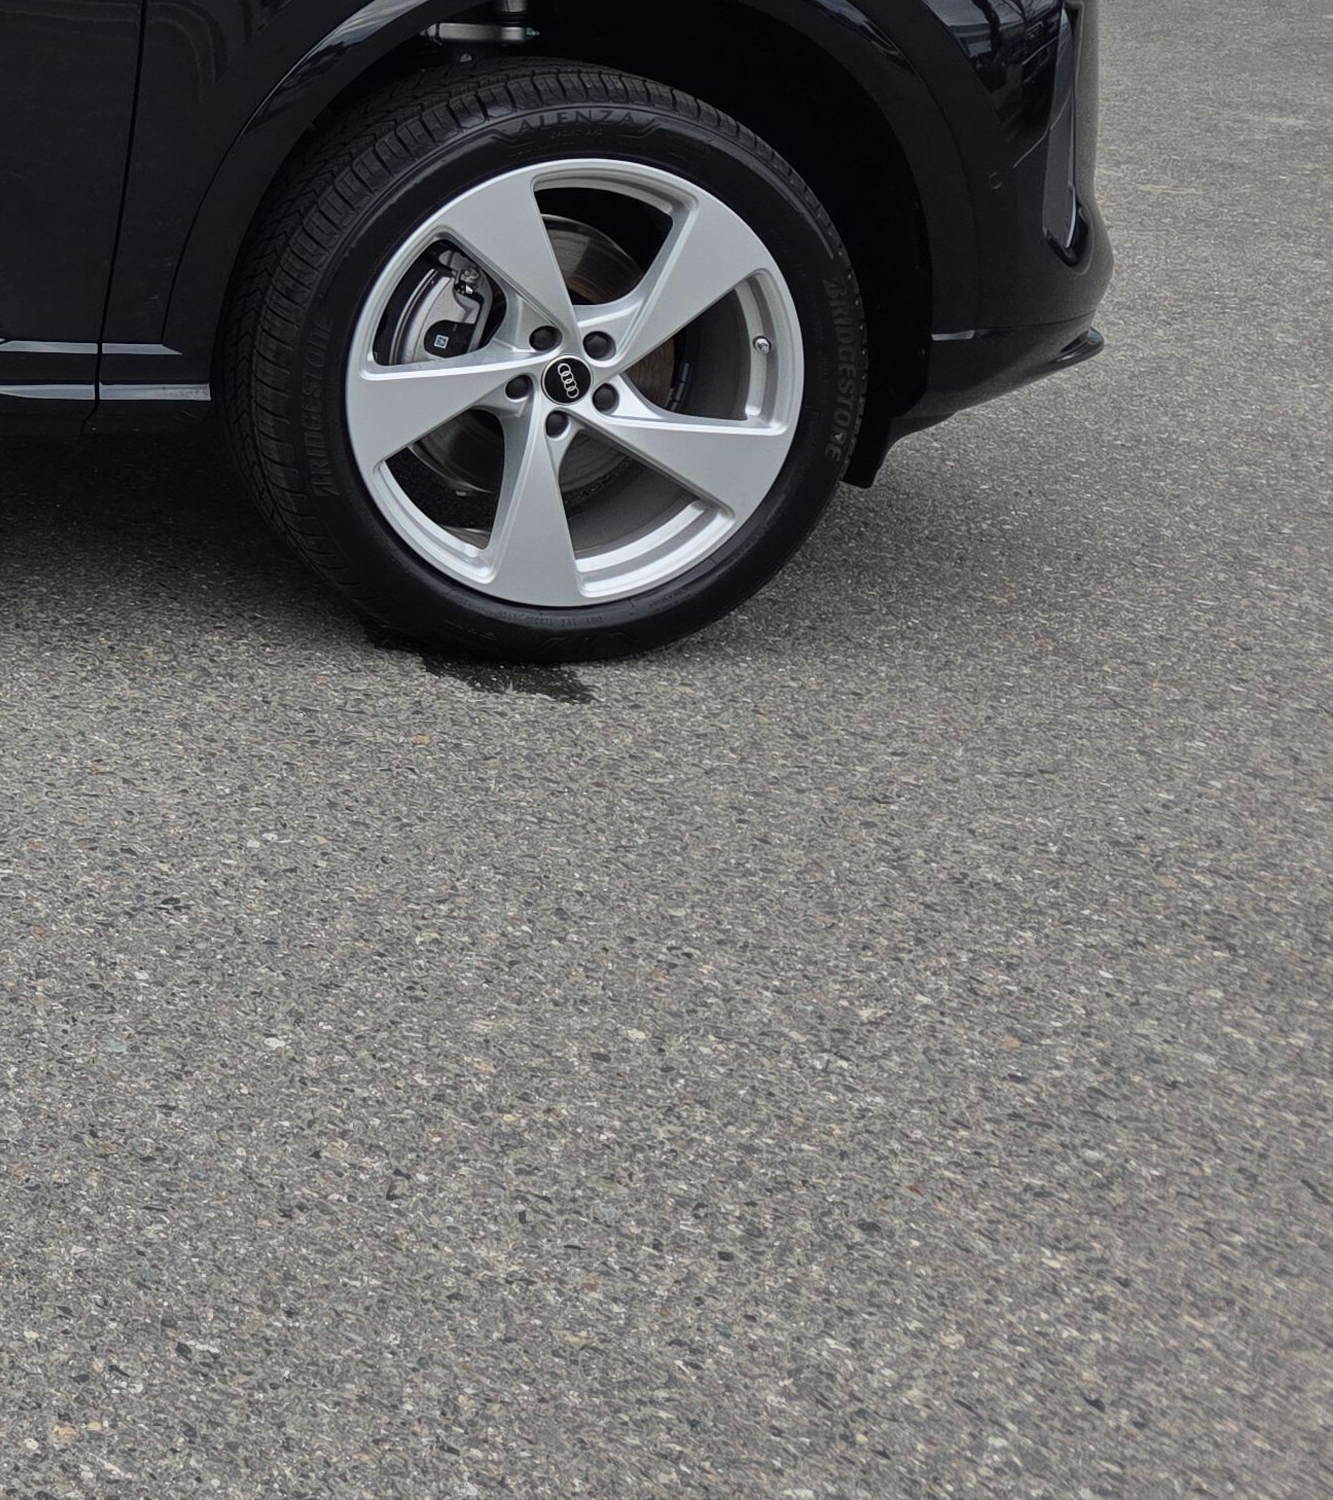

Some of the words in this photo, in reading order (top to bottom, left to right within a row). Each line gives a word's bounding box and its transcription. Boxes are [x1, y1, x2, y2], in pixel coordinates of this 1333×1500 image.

[518, 109, 636, 135] ALENZA
[300, 316, 340, 497] BRIDGESTONE
[822, 276, 857, 462] BRIDGESTONE
